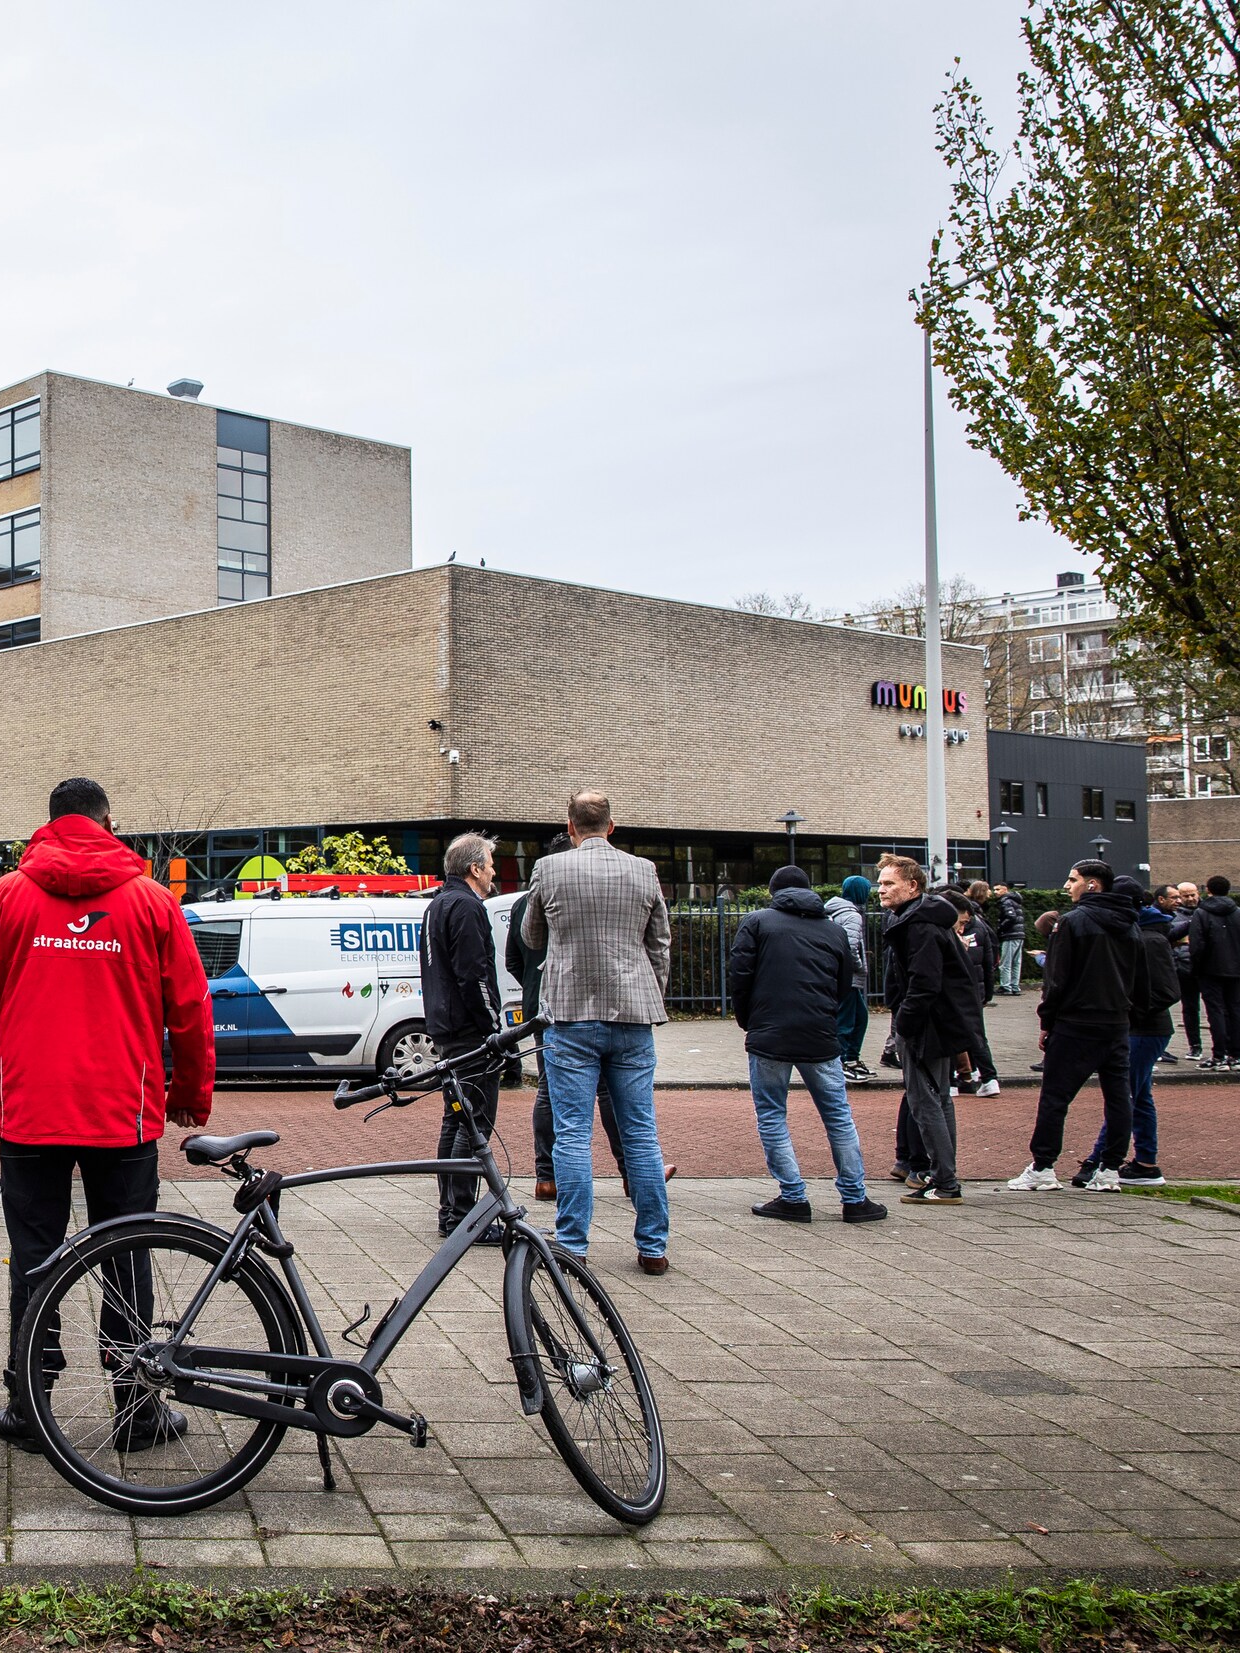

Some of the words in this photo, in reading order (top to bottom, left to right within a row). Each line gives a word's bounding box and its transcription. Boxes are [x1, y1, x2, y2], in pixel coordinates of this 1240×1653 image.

[873, 679, 968, 713] munus
[899, 723, 969, 744] coege
[32, 934, 122, 953] straatcoach
[342, 923, 422, 950] smi
[340, 953, 419, 962] ELEKTROTECHN
[213, 1024, 238, 1032] IEK.NL
